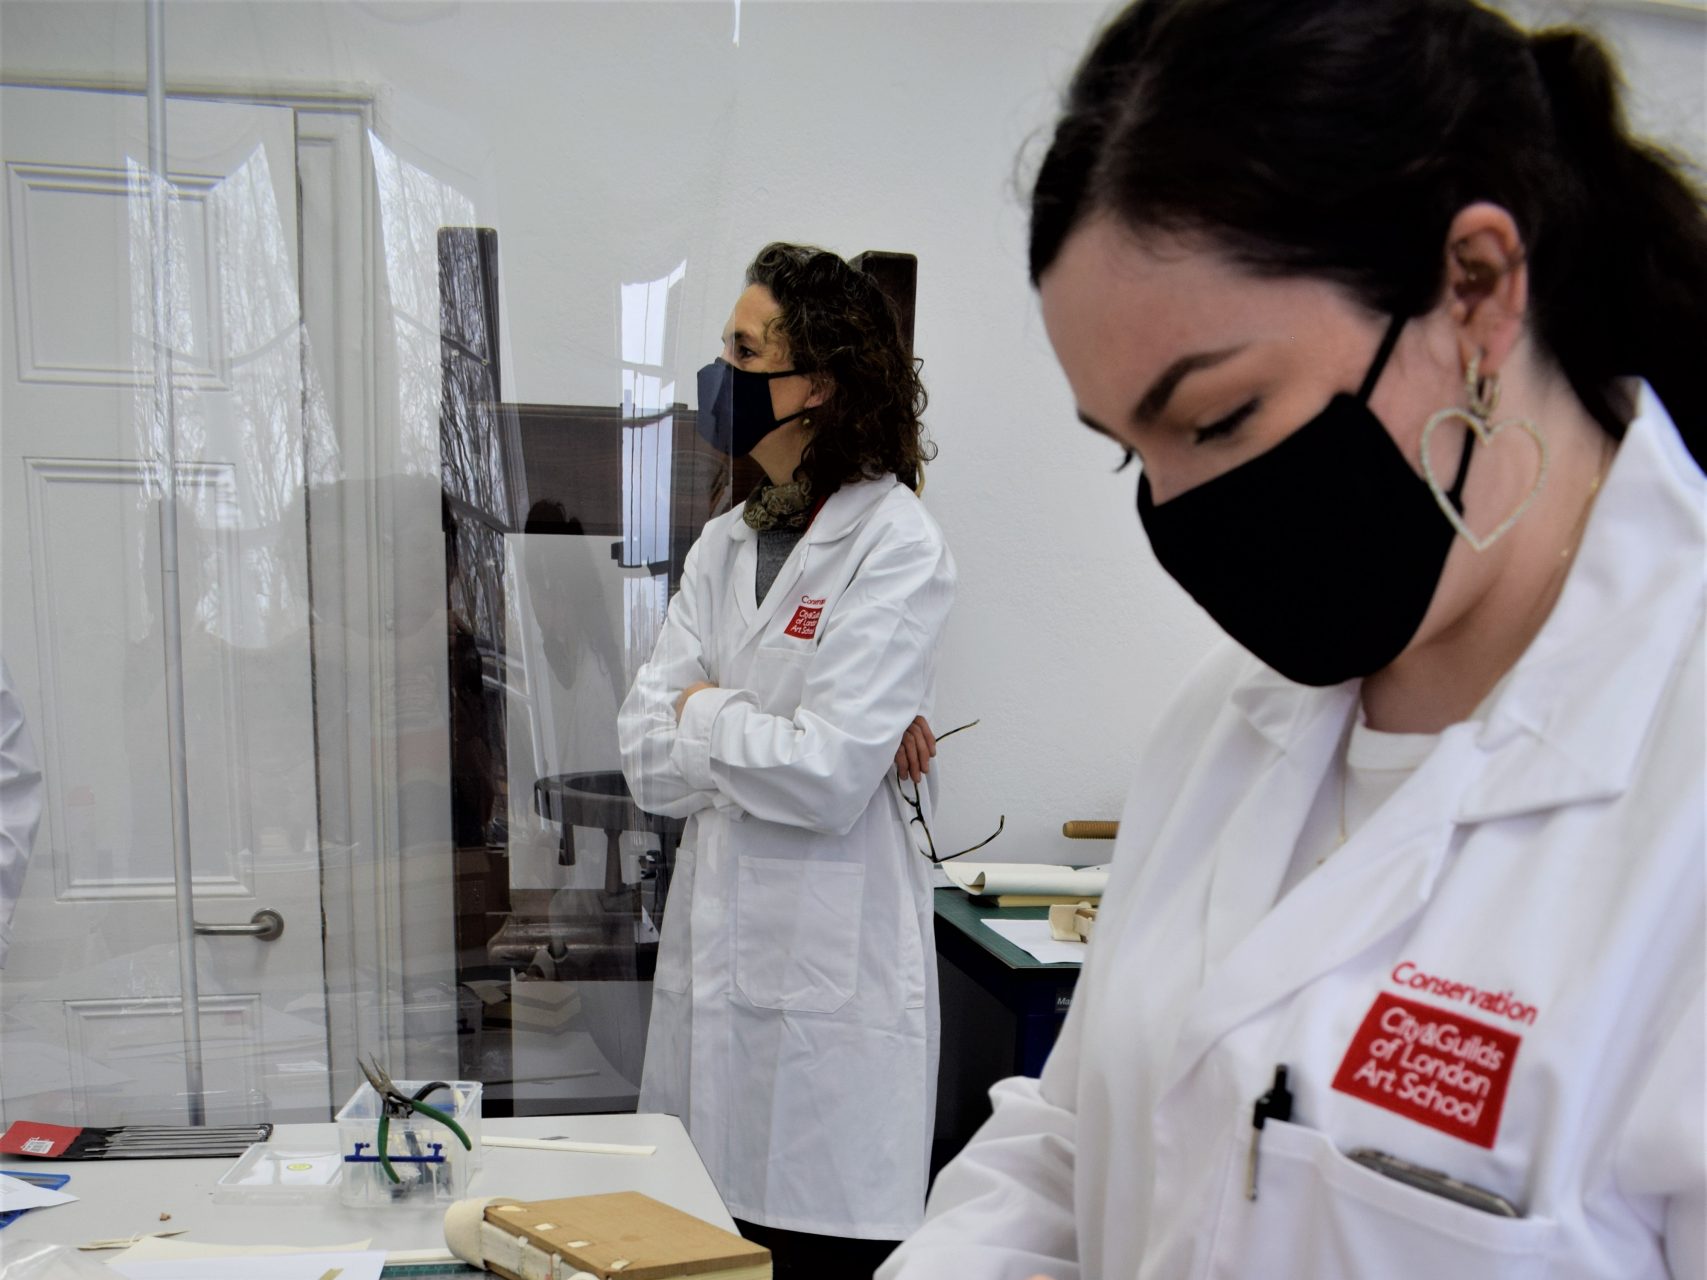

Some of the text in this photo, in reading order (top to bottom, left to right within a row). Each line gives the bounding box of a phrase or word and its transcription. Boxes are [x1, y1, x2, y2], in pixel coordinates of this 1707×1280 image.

[790, 625, 802, 633] Art
[795, 617, 804, 625] of
[1391, 961, 1538, 1026] Conservation
[1369, 1038, 1491, 1098] of London
[1380, 1006, 1504, 1071] City&Guilds
[1353, 1058, 1484, 1126] Art School
